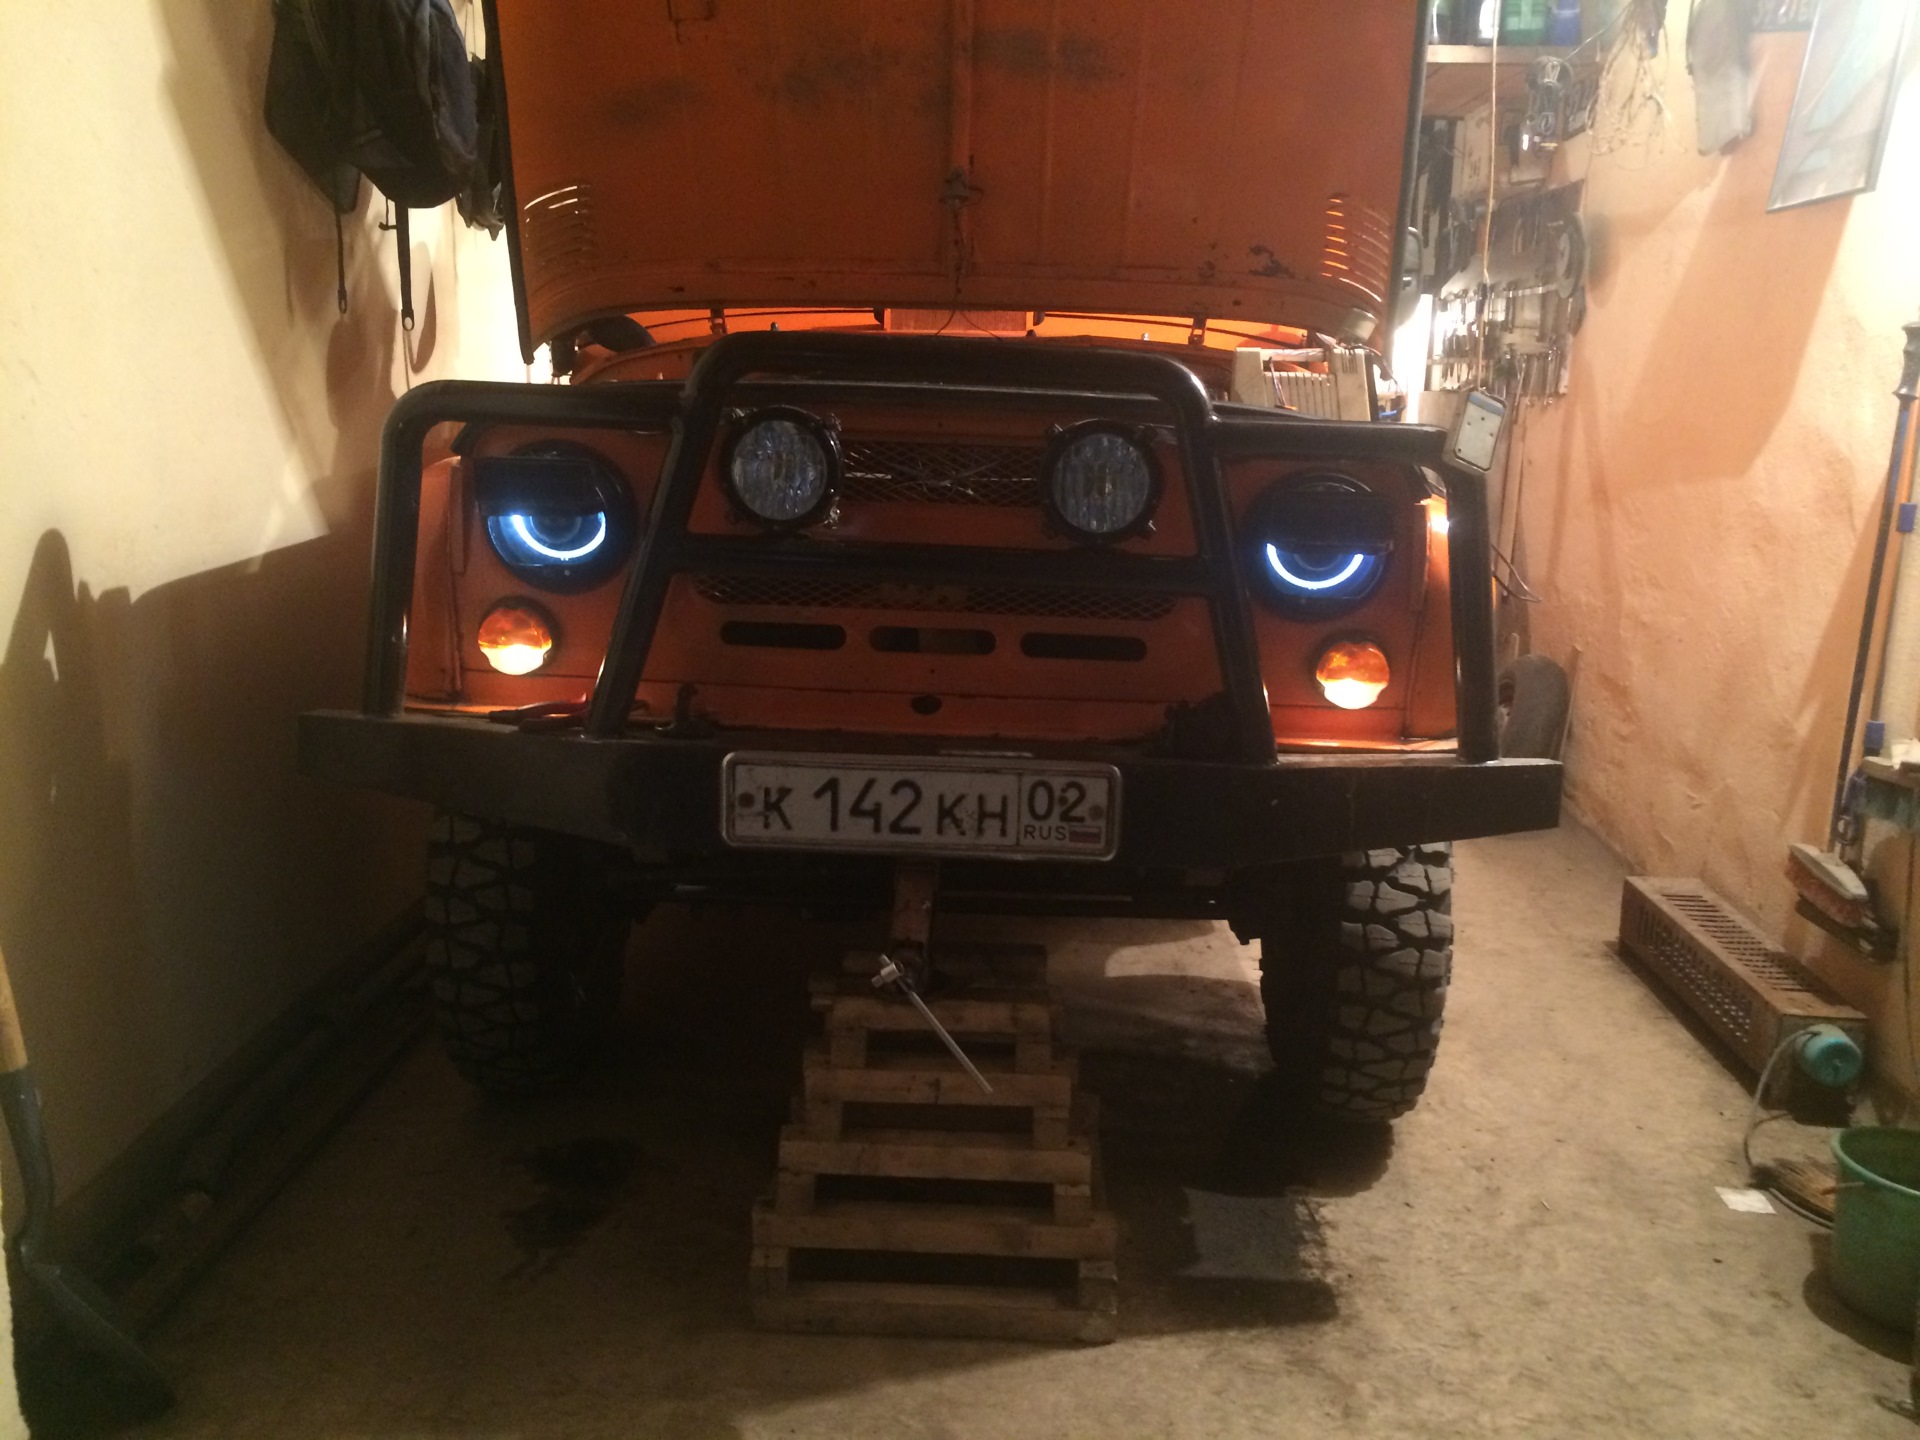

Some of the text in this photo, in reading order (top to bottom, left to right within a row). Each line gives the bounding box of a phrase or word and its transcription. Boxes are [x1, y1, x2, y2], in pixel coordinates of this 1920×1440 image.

[814, 777, 922, 835] 142
[1027, 779, 1086, 823] 02
[1024, 824, 1067, 841] RUS
